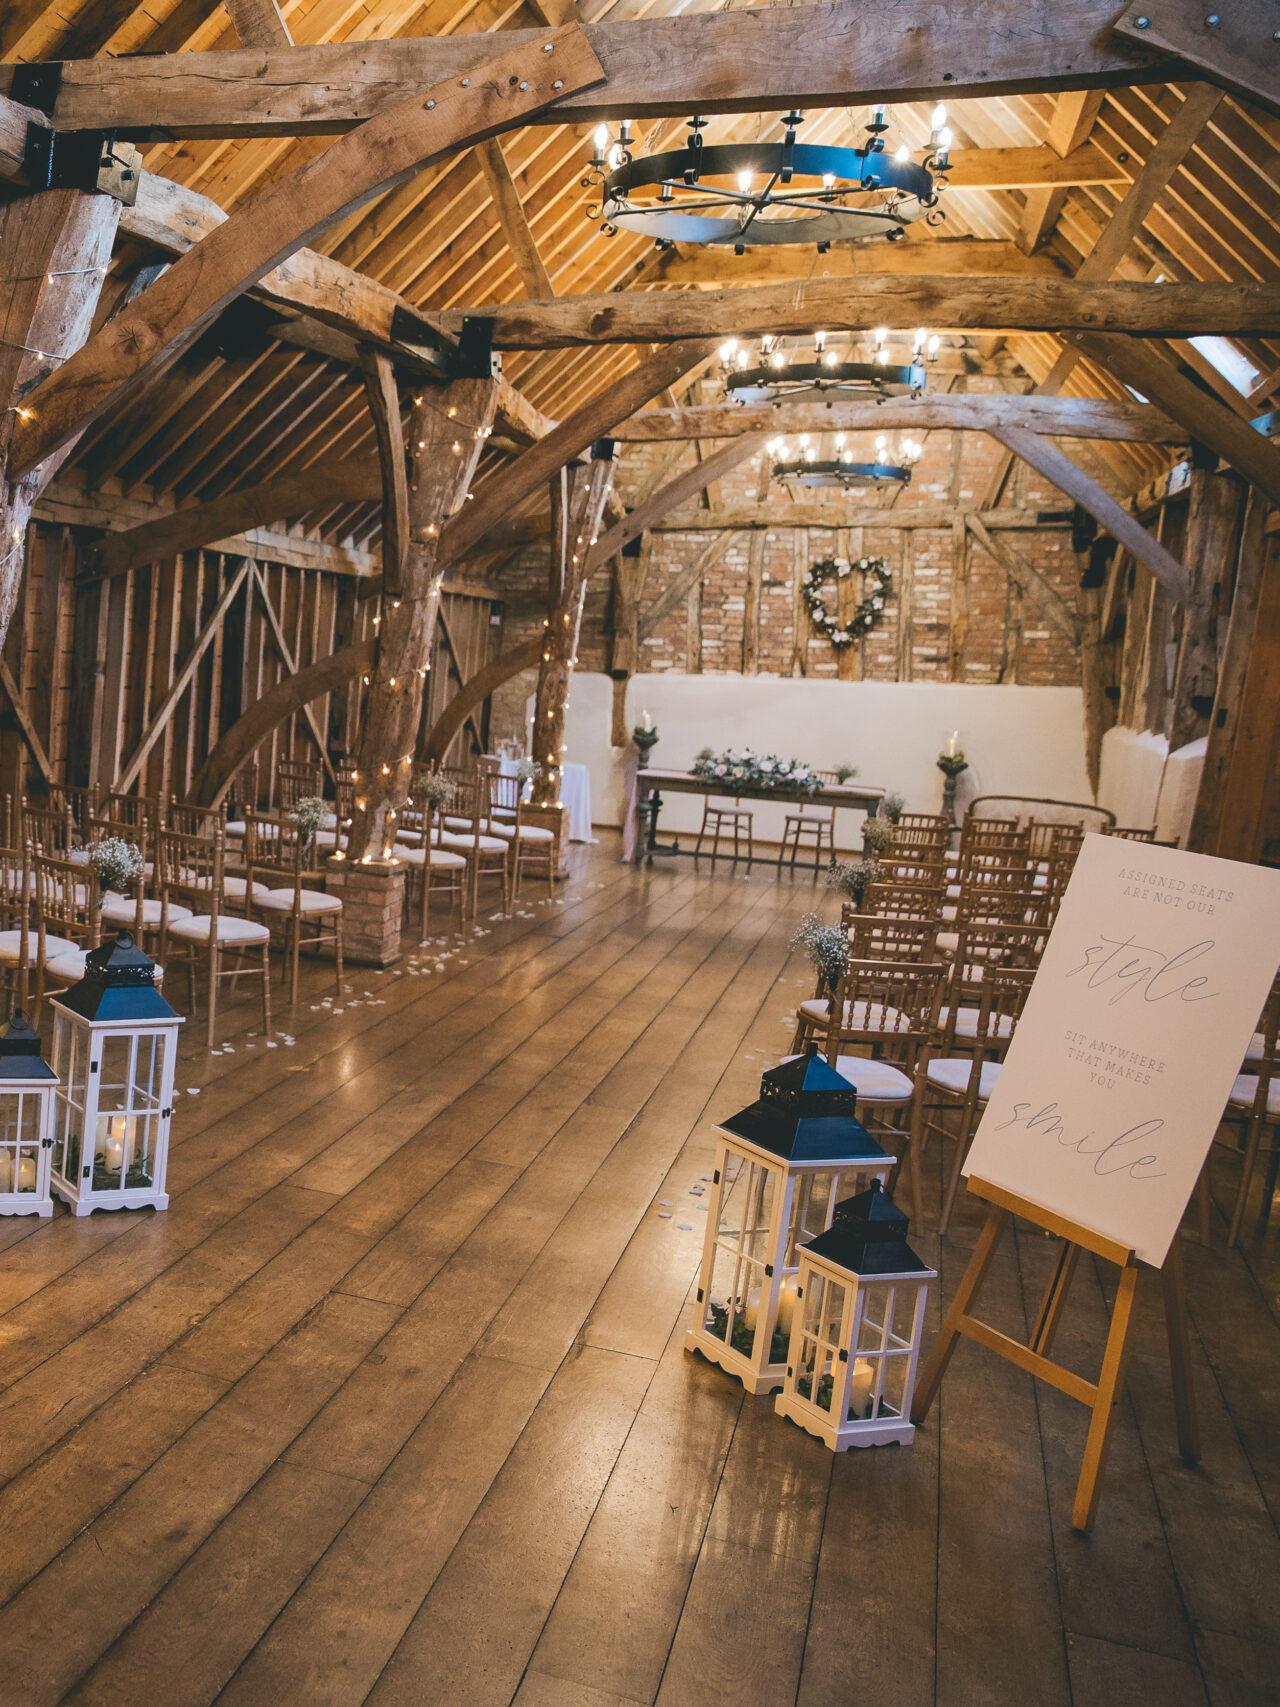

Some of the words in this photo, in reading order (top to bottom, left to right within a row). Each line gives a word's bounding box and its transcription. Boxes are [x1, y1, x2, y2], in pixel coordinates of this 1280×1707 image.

[1118, 868, 1186, 891] ASSIGNED
[1189, 883, 1235, 903] SEATS
[1123, 886, 1150, 900] ARE
[1153, 892, 1183, 908] NOT
[1186, 900, 1216, 916] OUR
[1065, 934, 1221, 1006] style
[1064, 1030, 1087, 1046] SIT
[1088, 1040, 1166, 1073] ANYWHERE
[1067, 1047, 1102, 1067] THAT
[1105, 1061, 1152, 1086] MAKES
[1089, 1071, 1116, 1089] YOU
[993, 1102, 1168, 1180] smile
